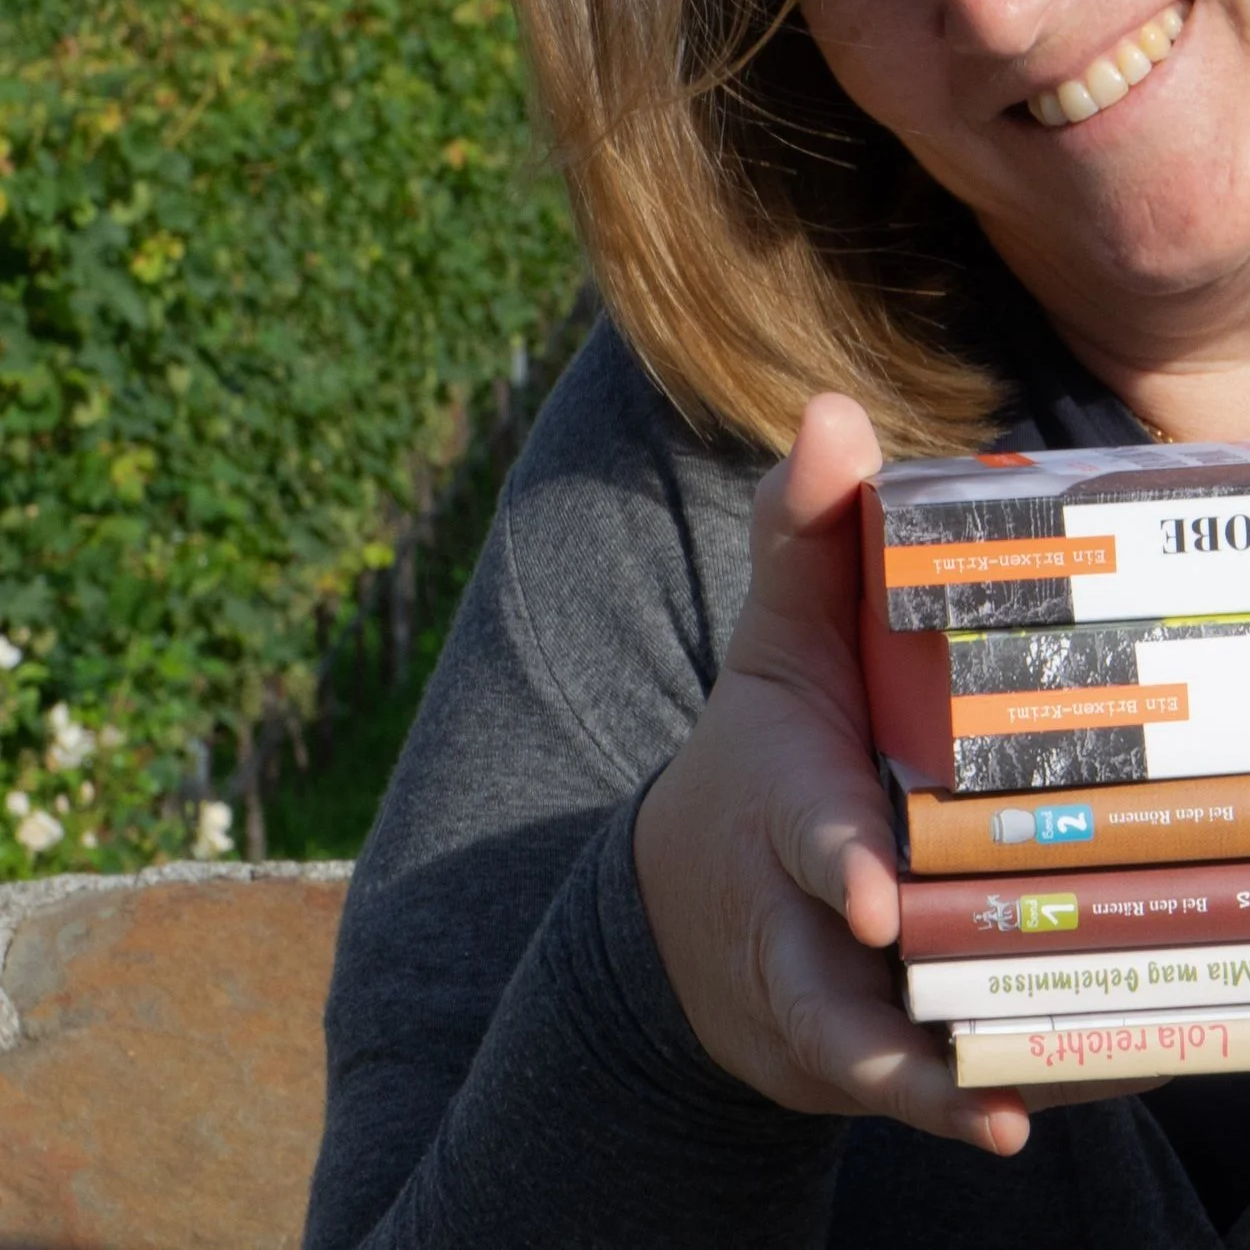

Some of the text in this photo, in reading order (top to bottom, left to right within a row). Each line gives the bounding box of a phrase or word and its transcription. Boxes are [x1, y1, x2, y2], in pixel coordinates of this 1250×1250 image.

[933, 549, 1106, 573] Ein Brixen-Krimi
[1007, 696, 1179, 722] Ein Brixen-Krimi
[1057, 811, 1088, 833] 2
[1108, 806, 1234, 826] Bei den Römern
[1041, 903, 1075, 925] 1
[1093, 897, 1208, 916] Bei den Rätern
[988, 965, 1139, 996] Geheimnisse
[1149, 961, 1198, 985] mag
[1029, 1024, 1229, 1068] Lola reicht's
